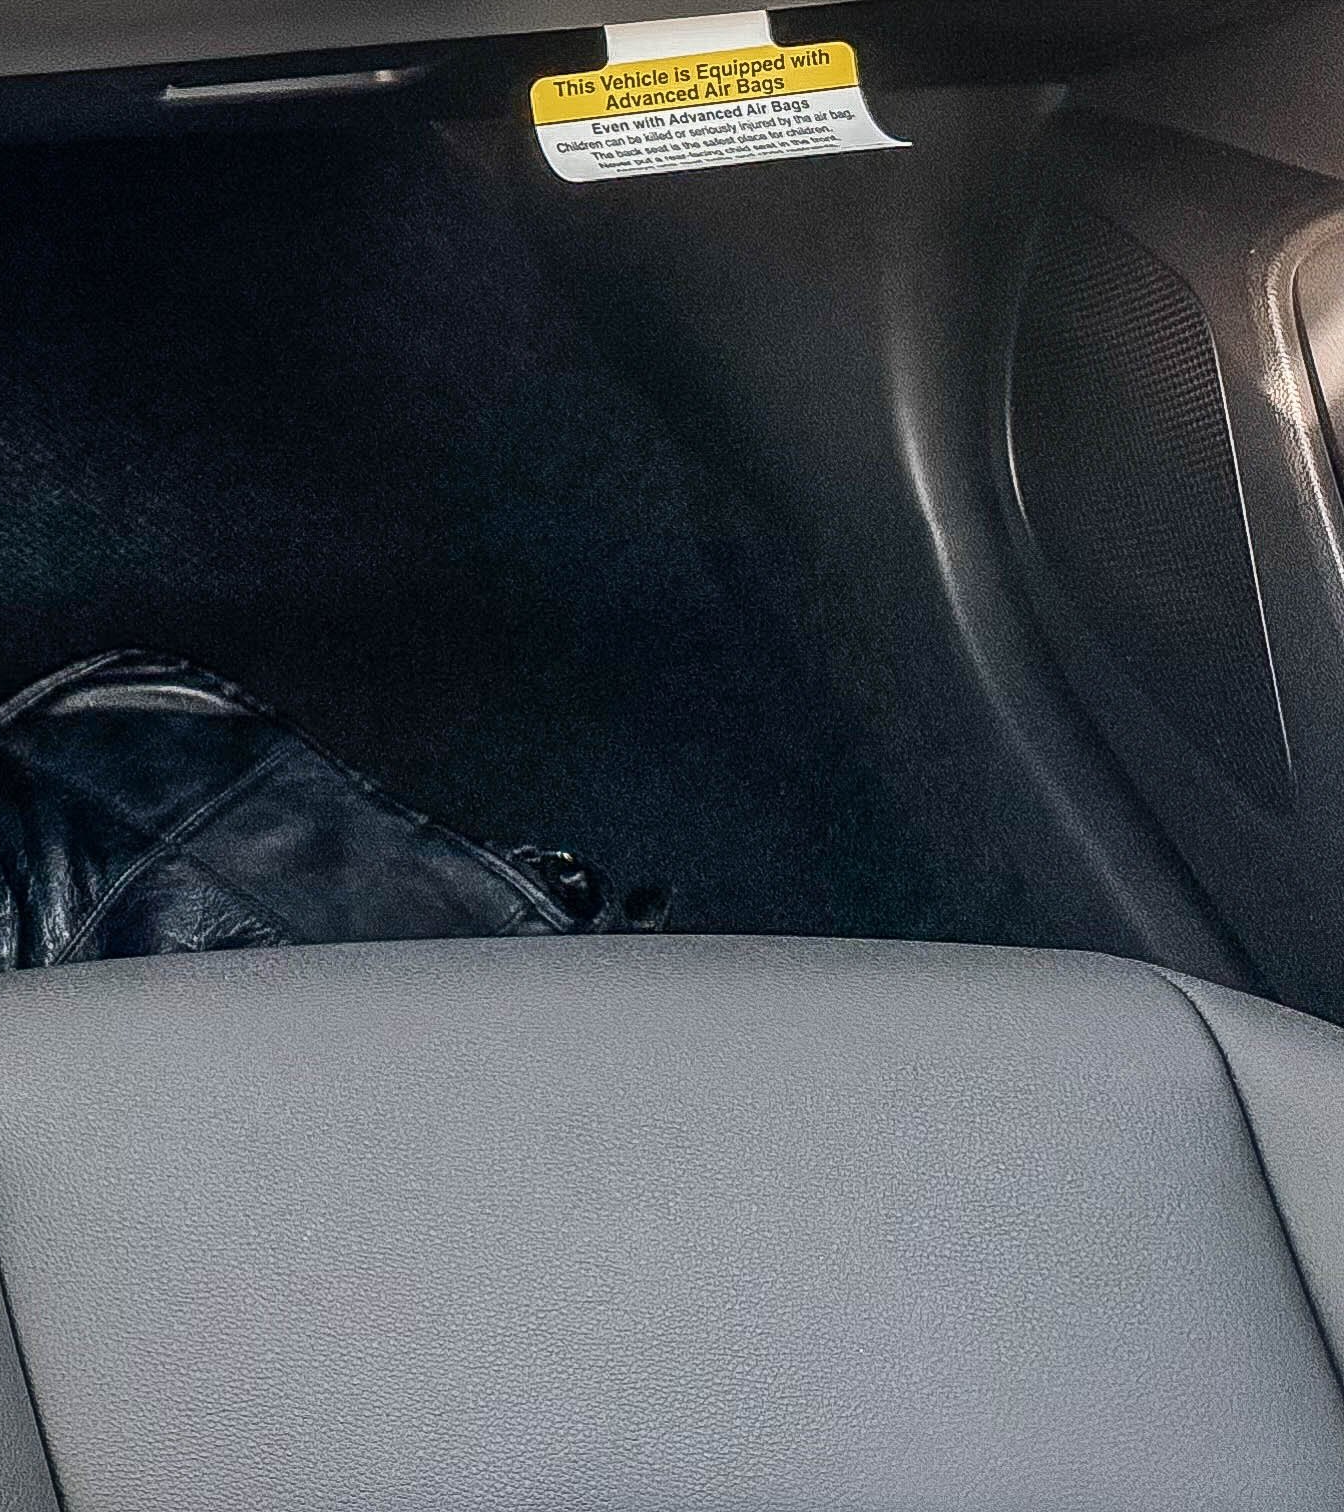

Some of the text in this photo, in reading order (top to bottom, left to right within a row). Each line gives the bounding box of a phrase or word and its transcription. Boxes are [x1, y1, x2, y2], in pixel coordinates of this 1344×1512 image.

[554, 49, 831, 98] This Vehicle is Equipped with
[606, 74, 786, 112] Advanced Air Bags
[556, 139, 604, 153] Children
[605, 137, 626, 148] can
[628, 133, 643, 144] be
[644, 129, 672, 141] killed
[674, 130, 686, 139] or
[689, 122, 737, 137] seriously
[738, 117, 777, 133] injured
[777, 116, 792, 127] by
[814, 110, 828, 122] air
[829, 108, 855, 121] bag.
[591, 98, 811, 135] Even with Advanced Air Bags
[591, 151, 613, 161] The
[644, 145, 668, 155] seat
[682, 140, 701, 150] the
